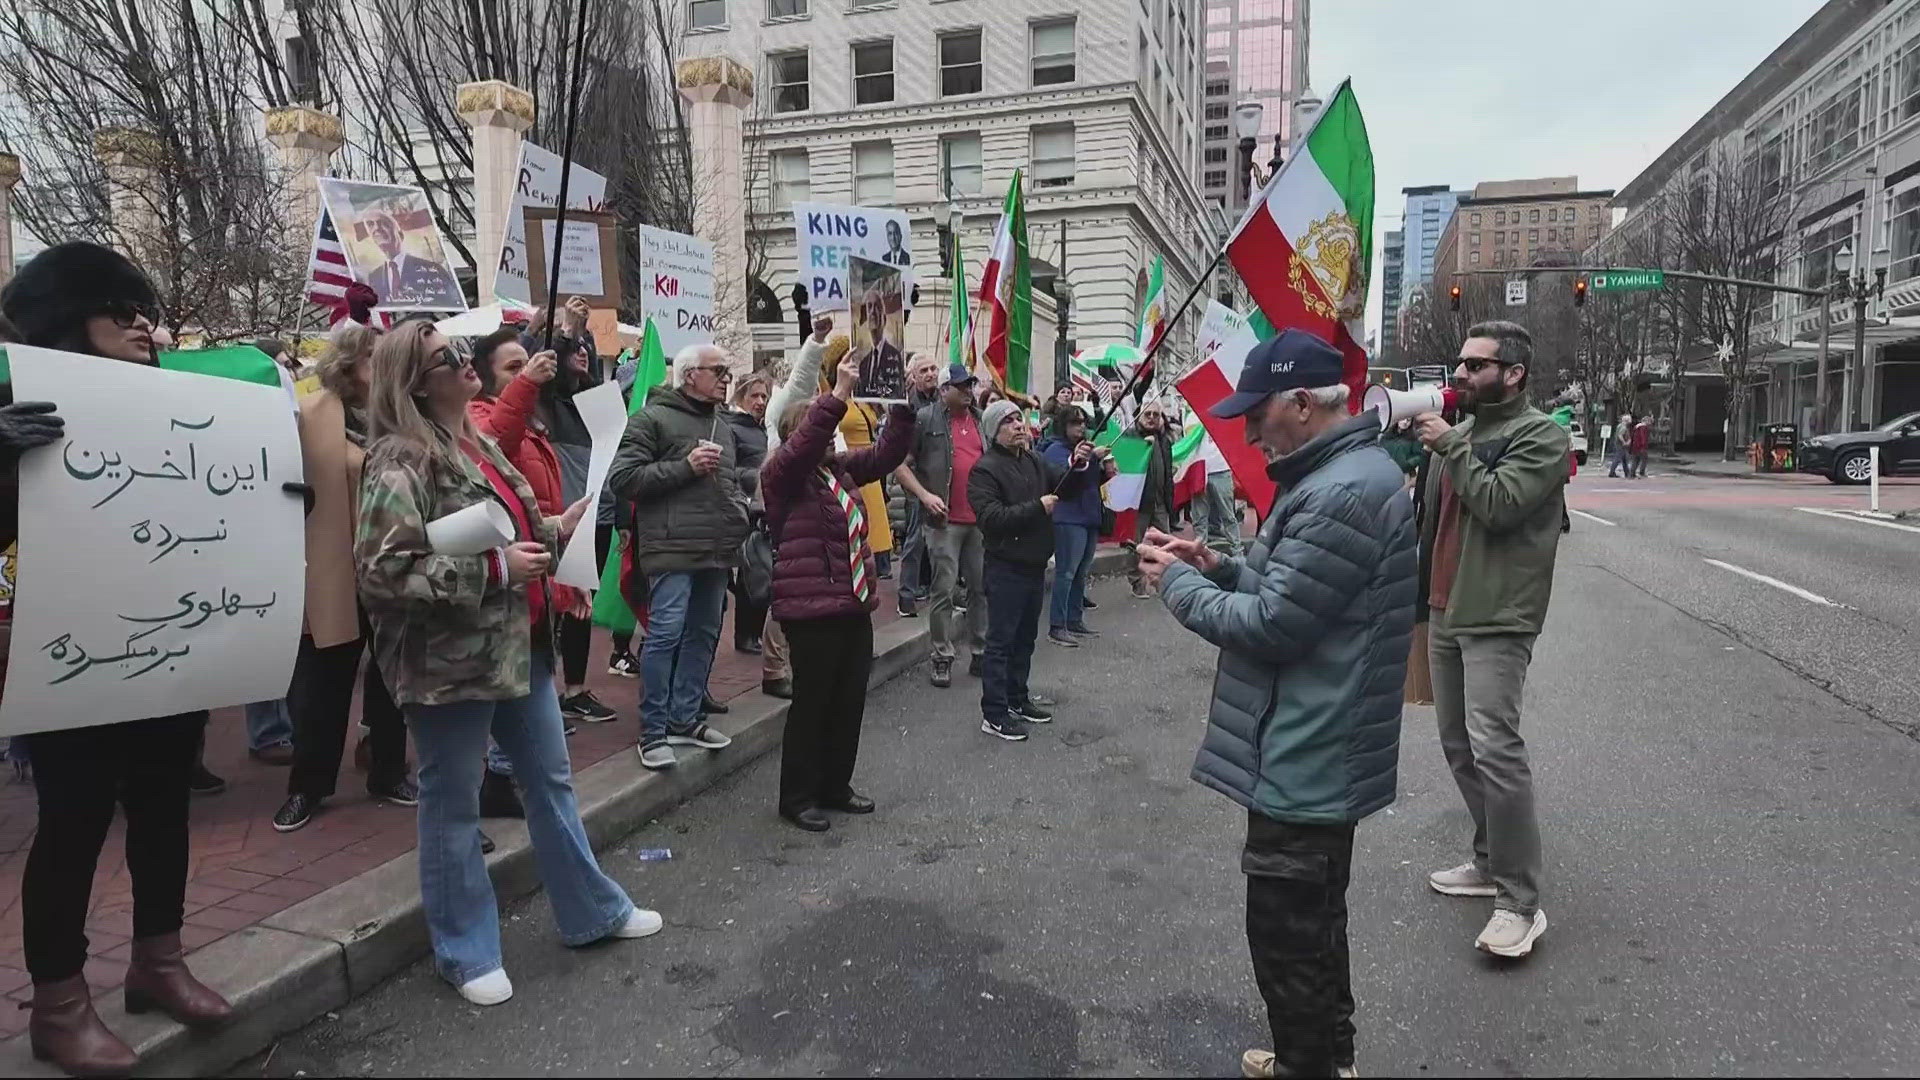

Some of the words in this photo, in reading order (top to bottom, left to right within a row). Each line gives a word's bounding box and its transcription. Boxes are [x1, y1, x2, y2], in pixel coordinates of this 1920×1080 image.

[807, 211, 869, 239] KING
[654, 272, 679, 299] Kill
[1609, 275, 1660, 286] YAMHILL
[676, 308, 716, 333] DARK
[1270, 360, 1296, 374] USAF
[62, 414, 215, 510] آخرین
[206, 446, 269, 496] این
[130, 518, 228, 565] نبرده
[117, 586, 277, 629] پهلوی
